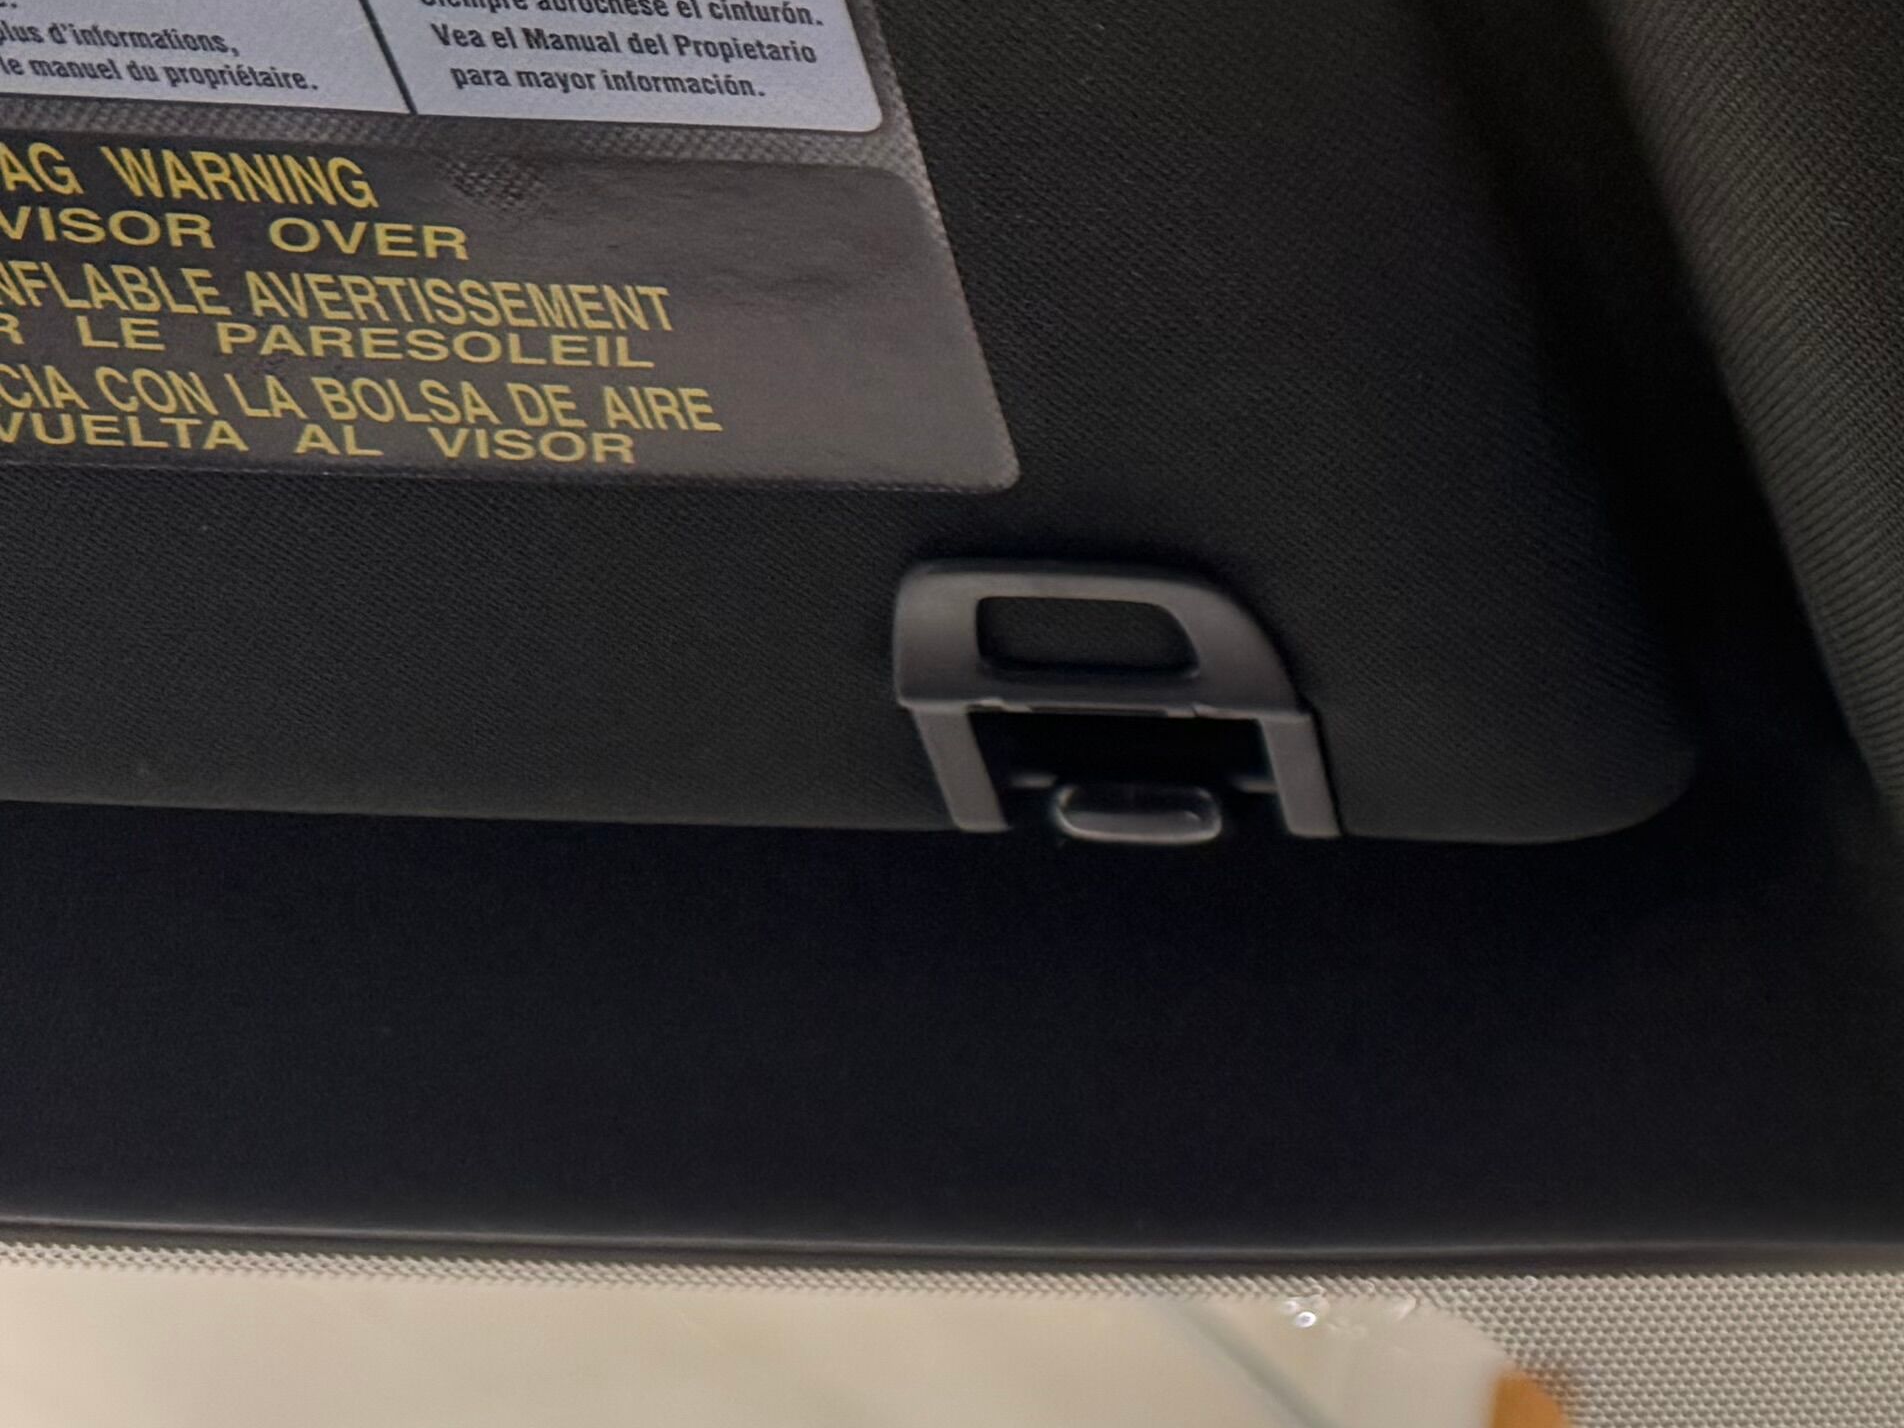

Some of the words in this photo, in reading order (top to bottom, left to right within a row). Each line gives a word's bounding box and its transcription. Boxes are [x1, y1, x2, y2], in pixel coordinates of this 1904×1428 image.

[707, 0, 824, 28] cinturón.
[431, 23, 484, 49] Vea
[491, 25, 518, 50] el
[525, 27, 622, 55] Manual
[627, 32, 669, 56] del
[676, 34, 817, 65] Propietario
[29, 59, 123, 81] manuel
[126, 60, 160, 83] du
[162, 64, 319, 90] propriétaire.
[450, 65, 511, 91] para
[517, 68, 597, 94] mayor
[600, 69, 766, 98] información.
[0, 141, 84, 195] AG
[100, 147, 379, 208] WARNING
[269, 217, 469, 260] OVER
[245, 270, 673, 331] AVERTISSEMENT
[76, 316, 166, 351] LE
[216, 322, 654, 368] PARESOLEIL
[95, 366, 219, 415] CON
[224, 373, 309, 419] LA
[311, 376, 502, 425] BOLSA
[507, 383, 588, 429] DE
[602, 385, 723, 432] AIRE
[294, 423, 384, 457] AL
[427, 427, 635, 464] VISOR
